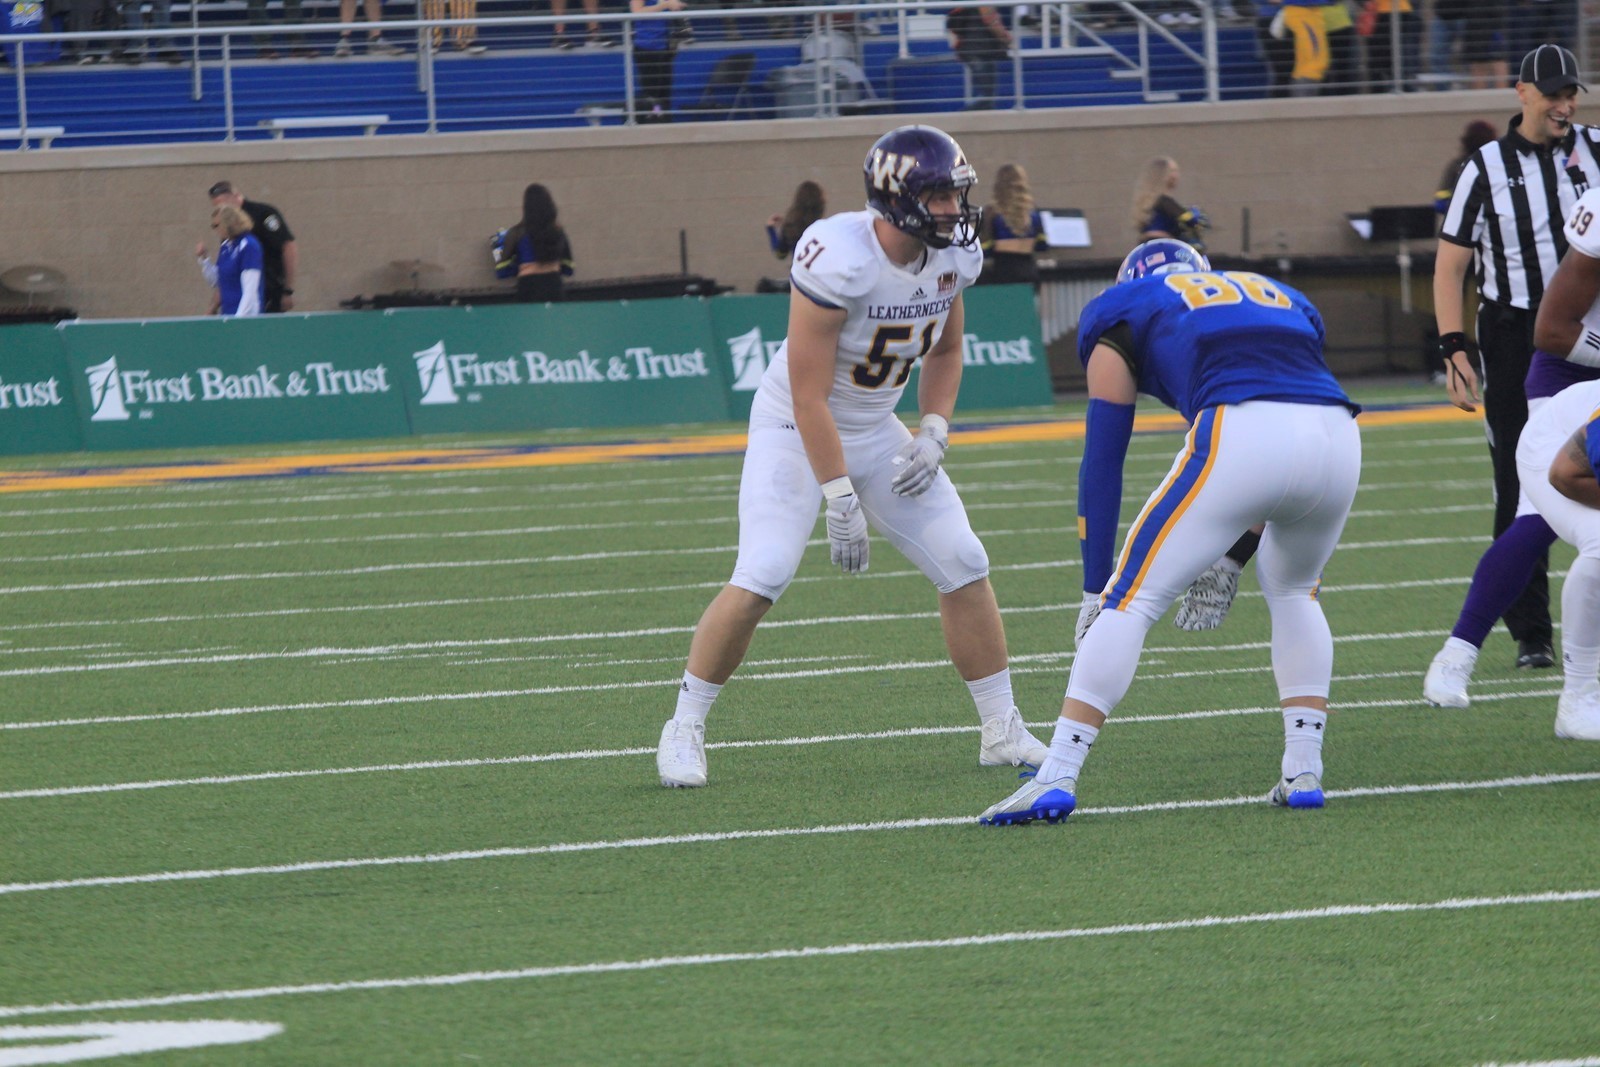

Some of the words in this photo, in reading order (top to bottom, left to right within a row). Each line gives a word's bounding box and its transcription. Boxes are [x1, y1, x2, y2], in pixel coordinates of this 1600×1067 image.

[873, 148, 916, 194] W
[1569, 205, 1594, 237] 39
[796, 238, 825, 270] 51
[868, 296, 955, 320] LEATHERNECKS
[449, 353, 522, 388] First
[524, 350, 605, 384] Bank
[606, 355, 631, 382] &
[626, 347, 709, 379] Trust
[851, 319, 938, 389] 51
[0, 375, 62, 410] rust
[120, 370, 196, 405] First
[197, 364, 283, 402] Bank
[286, 371, 310, 398] &
[306, 361, 391, 396] Trust
